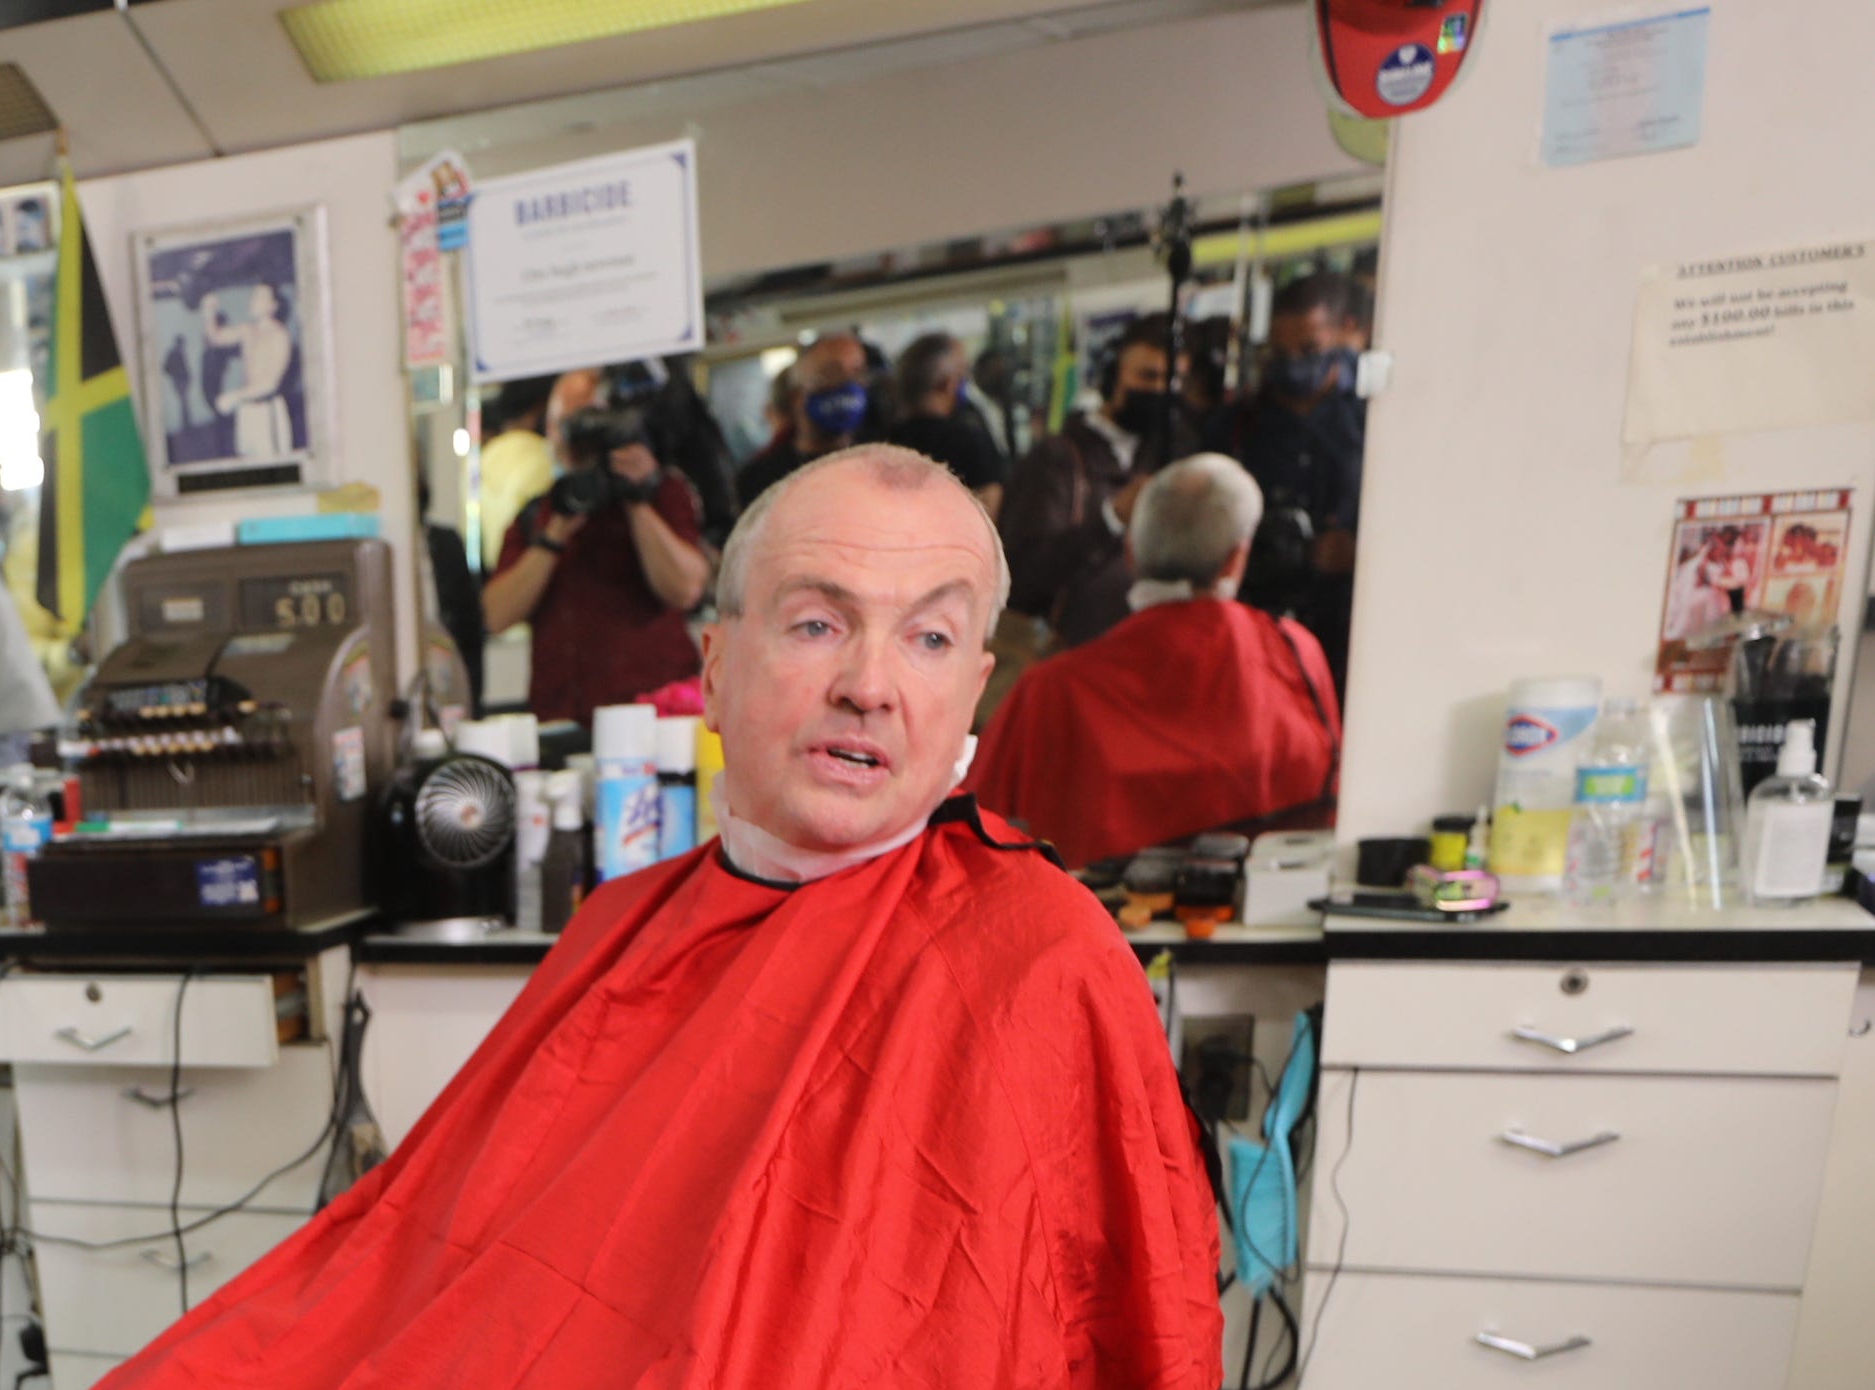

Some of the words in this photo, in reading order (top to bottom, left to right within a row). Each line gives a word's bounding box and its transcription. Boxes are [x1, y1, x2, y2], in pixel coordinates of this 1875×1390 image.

[516, 180, 632, 227] BARBICIDE
[1677, 256, 1764, 278] ATTENTION
[1757, 287, 1773, 300] be
[1778, 281, 1849, 297] accepting
[1700, 306, 1771, 327] $100.00
[1775, 303, 1805, 317] bills
[1809, 302, 1824, 314] in
[1827, 298, 1856, 313] this
